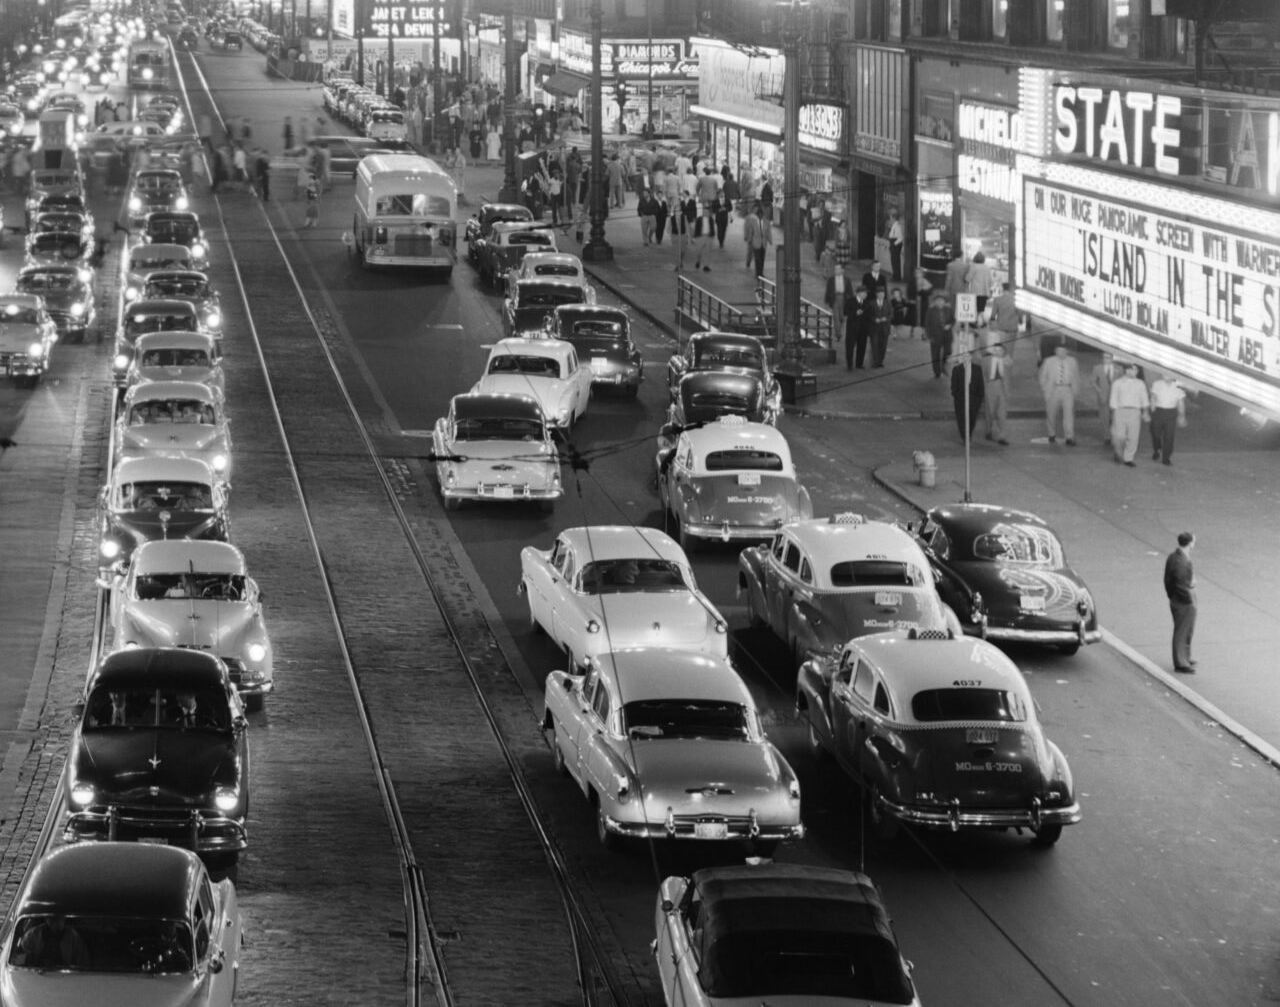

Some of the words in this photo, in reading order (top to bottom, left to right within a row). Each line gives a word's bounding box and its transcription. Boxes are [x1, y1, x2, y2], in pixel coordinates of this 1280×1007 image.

[618, 45, 675, 58] DIAMONDS
[618, 60, 671, 78] Chicago's
[1055, 85, 1182, 176] STATE
[1035, 187, 1045, 211] ON
[1050, 191, 1067, 218] OUR
[1071, 194, 1092, 225] HUGE
[1098, 202, 1149, 241] PANORAMIC
[1156, 218, 1195, 253] SCREEN
[1202, 230, 1228, 263] WITH
[962, 302, 970, 312] U
[1167, 254, 1185, 308] IN
[1202, 263, 1245, 328] THE
[1035, 263, 1056, 292] JOHN
[1060, 271, 1086, 304] WAYNE
[1103, 287, 1133, 321] LLOYD
[1137, 300, 1169, 335] NOLAN
[1190, 317, 1230, 358] WALTER
[1238, 335, 1267, 371] ABEL
[985, 761, 1022, 772] 6-3700
